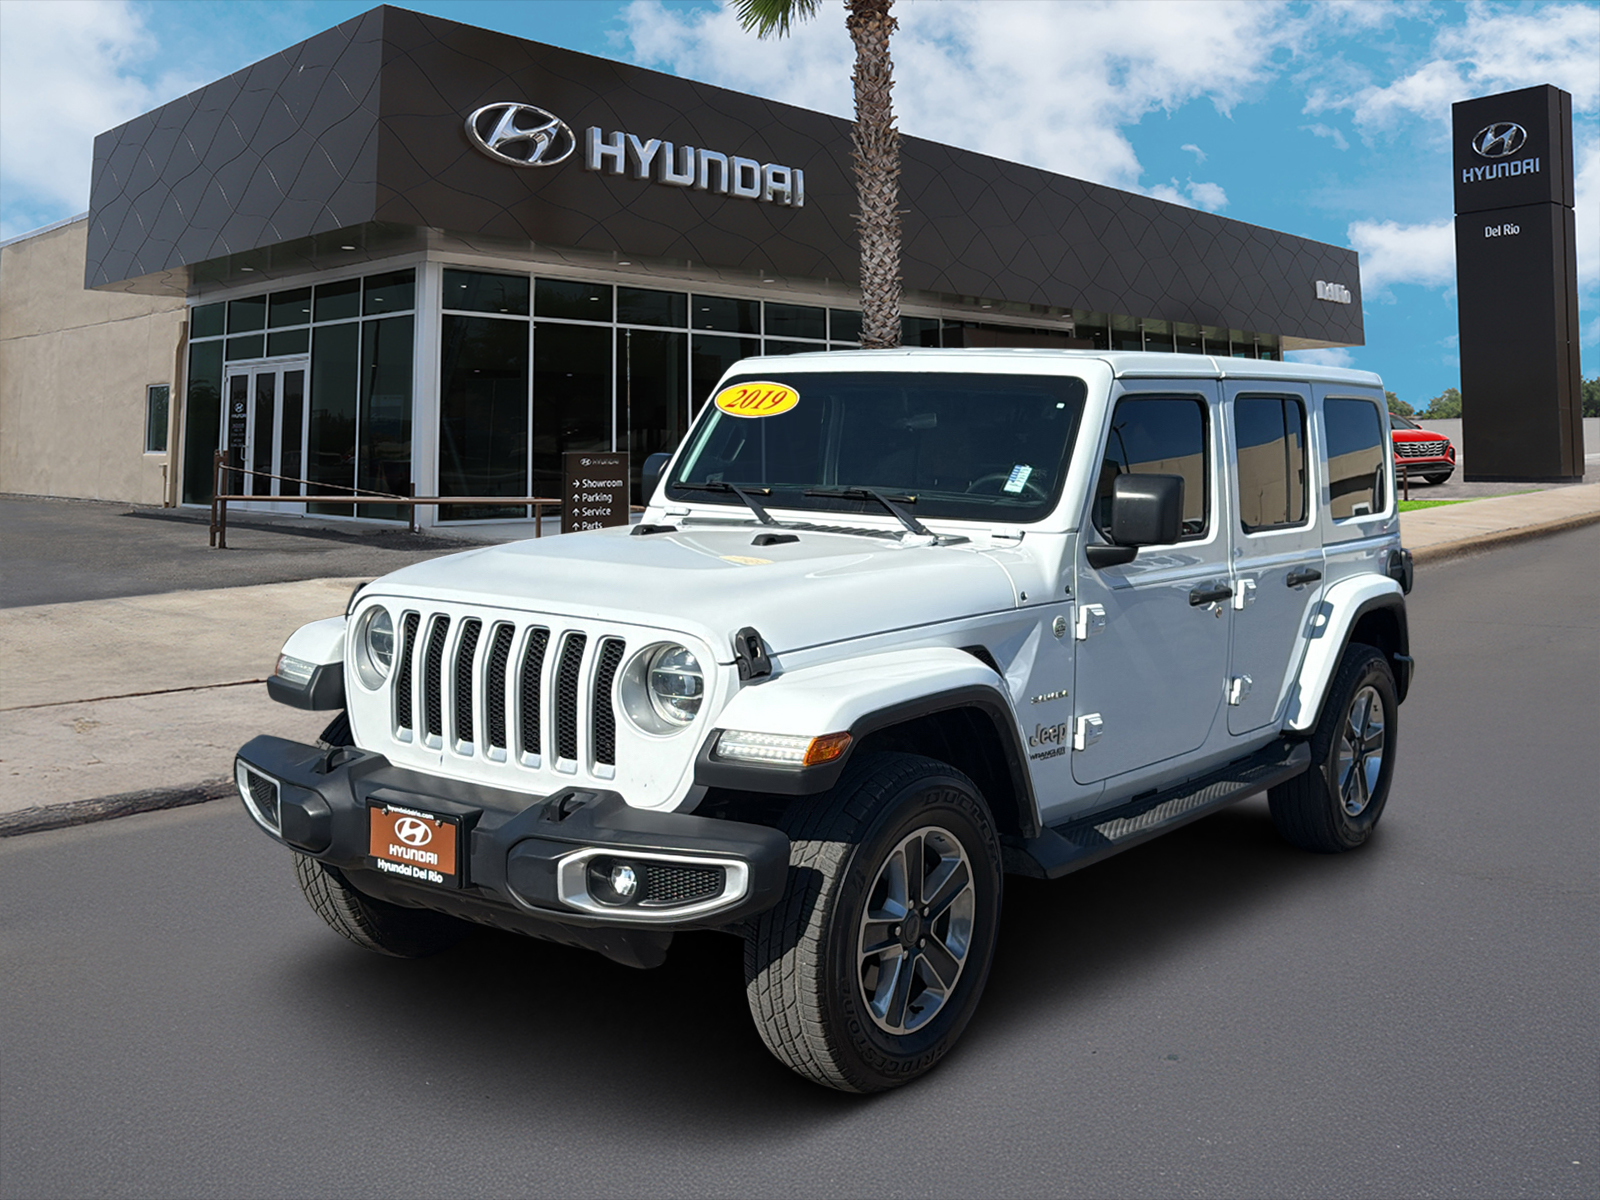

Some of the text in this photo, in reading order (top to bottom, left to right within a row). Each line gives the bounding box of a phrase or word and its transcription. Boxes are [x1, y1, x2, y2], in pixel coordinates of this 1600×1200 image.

[586, 126, 804, 208] HYUNDAI
[1462, 157, 1540, 184] HYUNDAI
[1484, 223, 1520, 238] Del Rio
[724, 389, 788, 410] 2019
[582, 479, 623, 488] Showroom
[582, 493, 612, 503] Parking
[582, 507, 611, 517] Service
[582, 522, 602, 530] Parts
[1029, 723, 1067, 747] Jeep
[389, 844, 437, 865] HYUNDAI
[378, 859, 443, 883] Hyundai Del Rio
